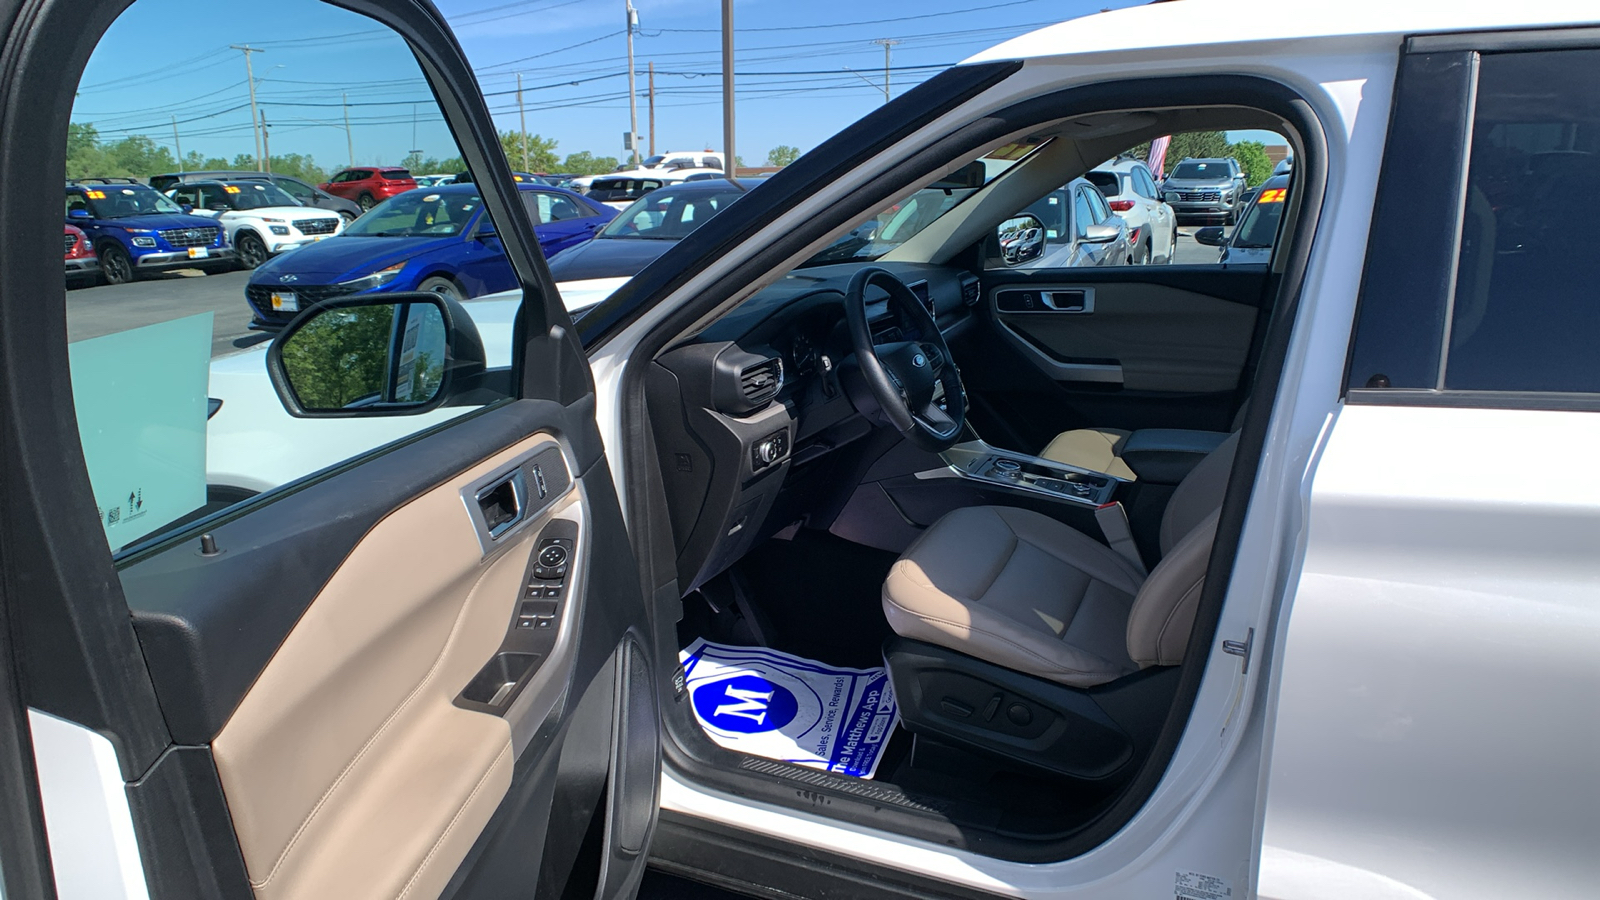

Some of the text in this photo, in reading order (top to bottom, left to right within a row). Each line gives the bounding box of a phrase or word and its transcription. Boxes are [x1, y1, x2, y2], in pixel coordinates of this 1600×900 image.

[713, 684, 775, 725] M
[815, 676, 845, 757] Sales, Service, Rewards!
[862, 690, 880, 711] App
[840, 711, 871, 755] Matthews
[831, 757, 850, 774] The
